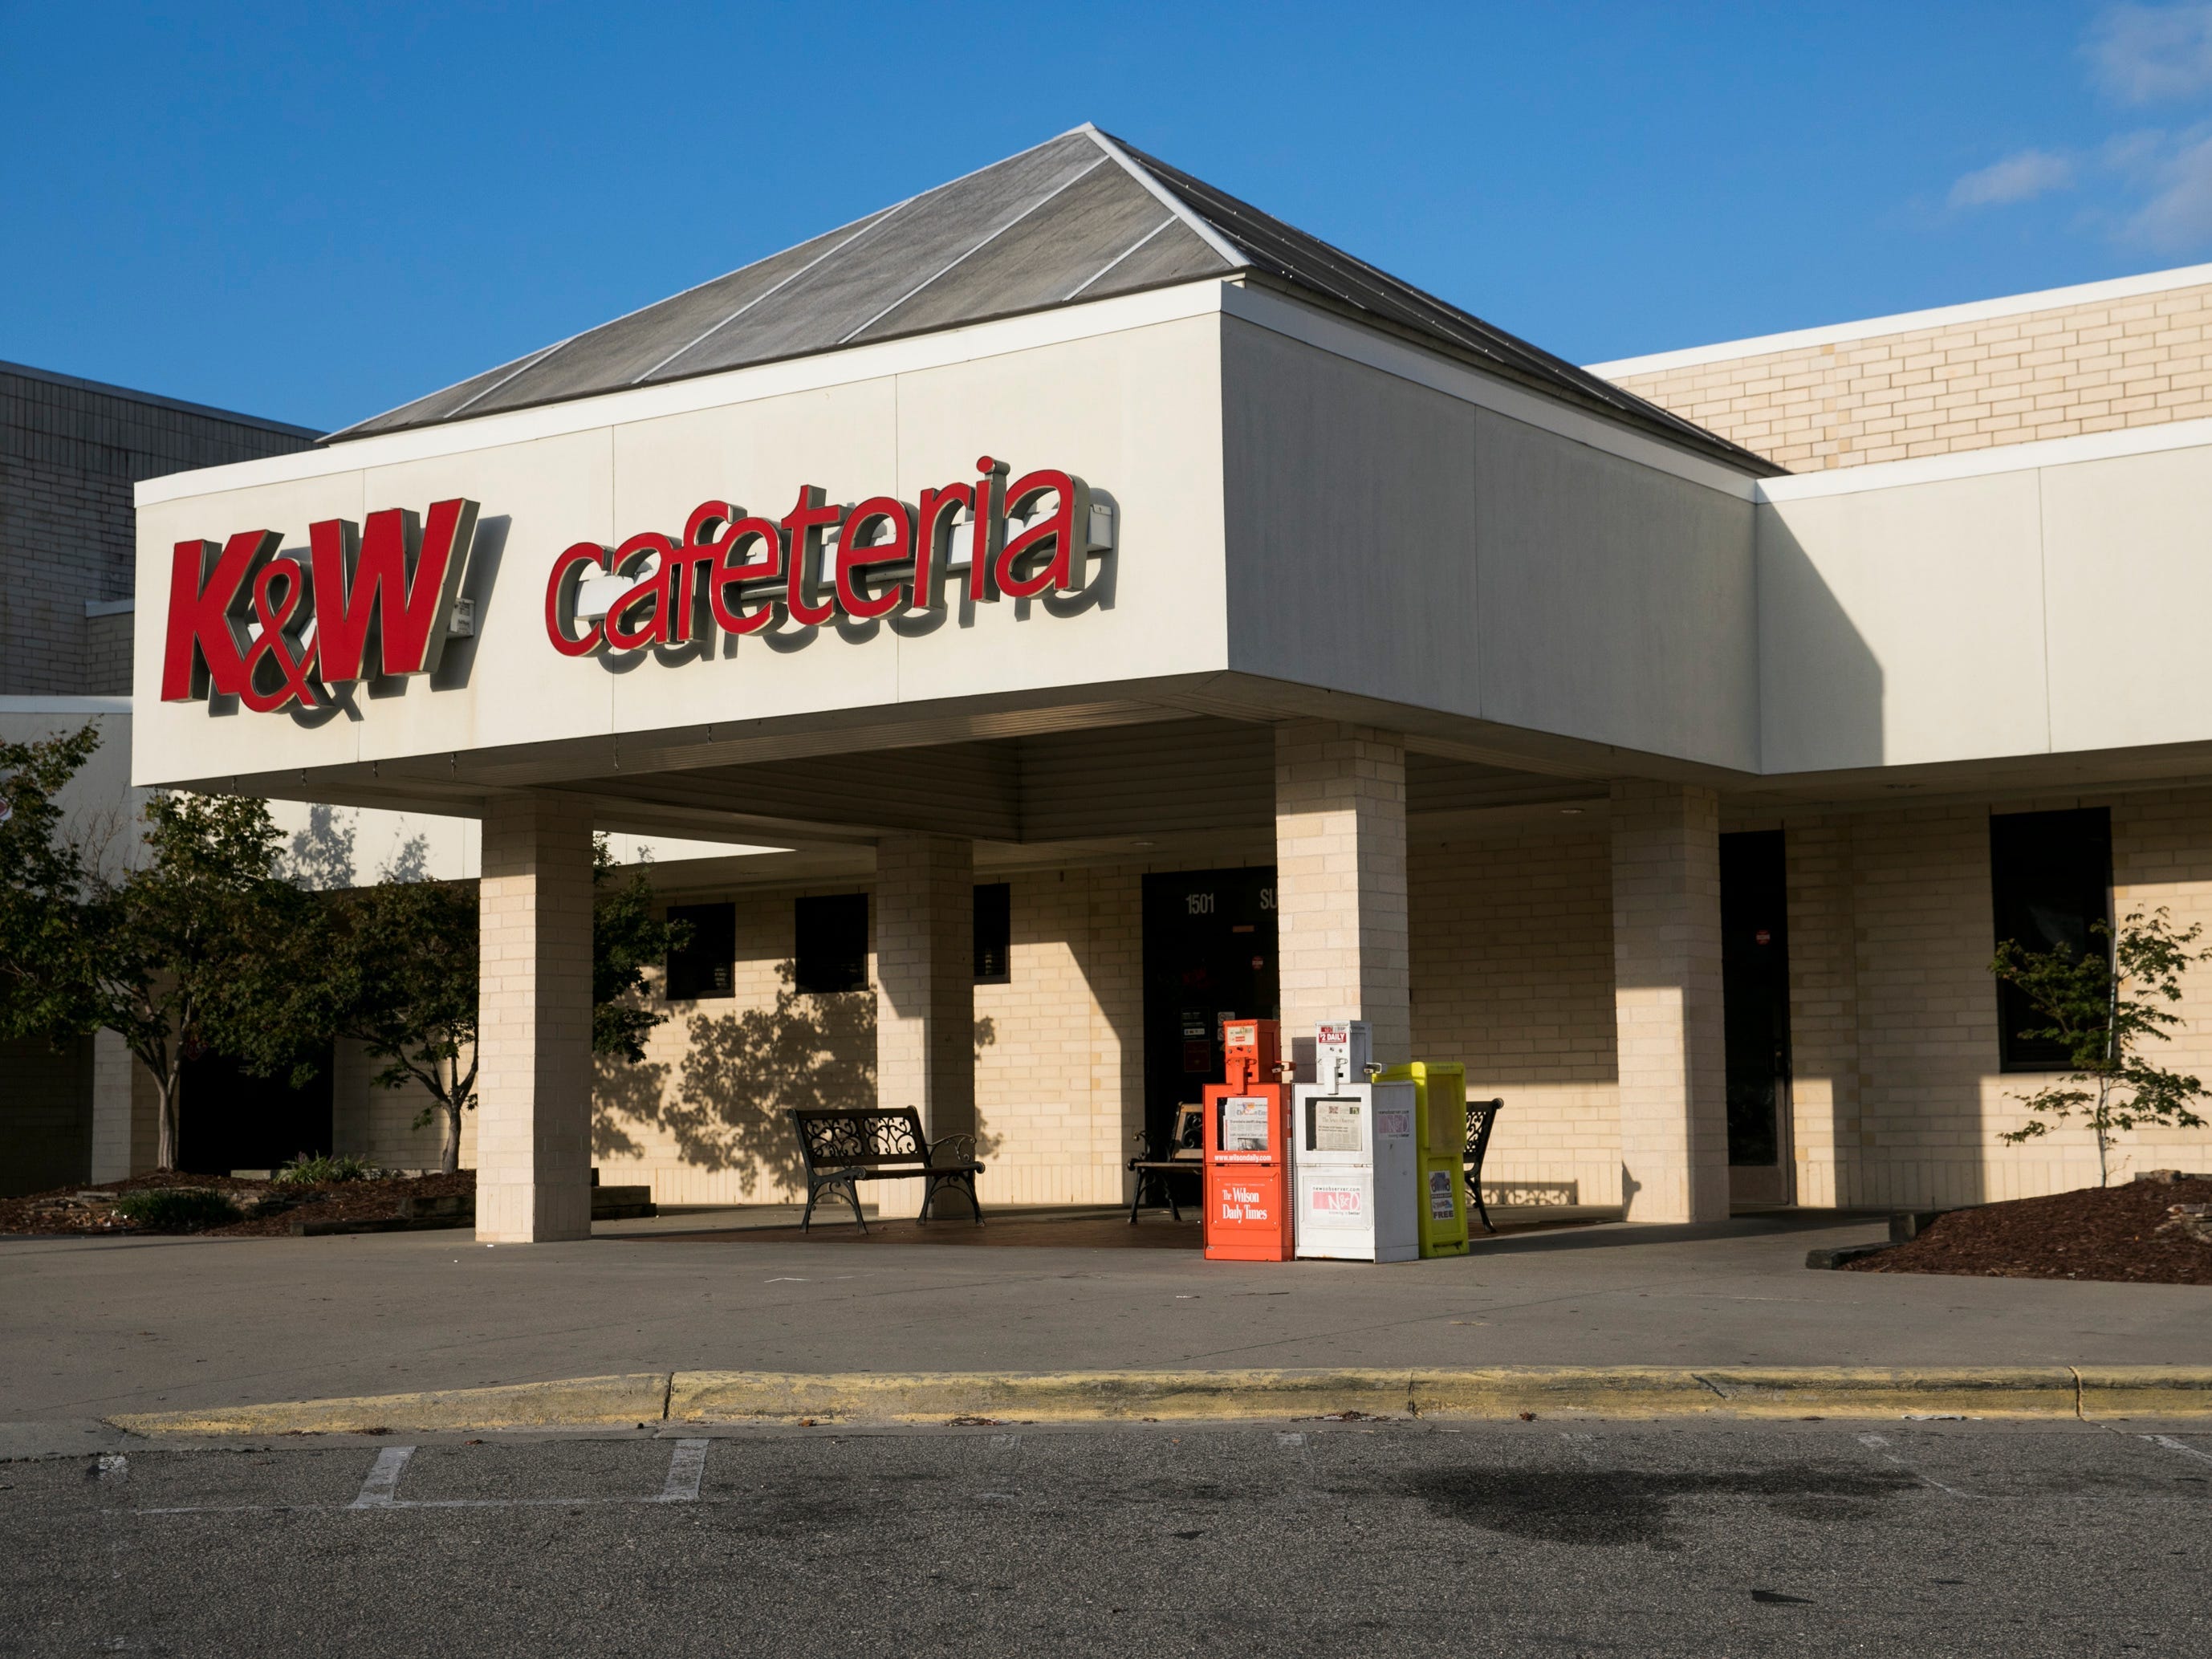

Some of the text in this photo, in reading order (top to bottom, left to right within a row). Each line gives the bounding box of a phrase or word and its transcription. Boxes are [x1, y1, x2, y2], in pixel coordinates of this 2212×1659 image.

[161, 455, 1081, 712] K&W cafeteria
[1185, 893, 1214, 914] 1501
[1327, 1033, 1344, 1041] DAILY
[1214, 1154, 1271, 1163] www.wilsondaily.com
[1222, 1188, 1259, 1203] The Wilson
[1328, 1192, 1360, 1210] N&O
[1222, 1204, 1267, 1223] Daily Times
[1433, 1210, 1454, 1219] FREE
